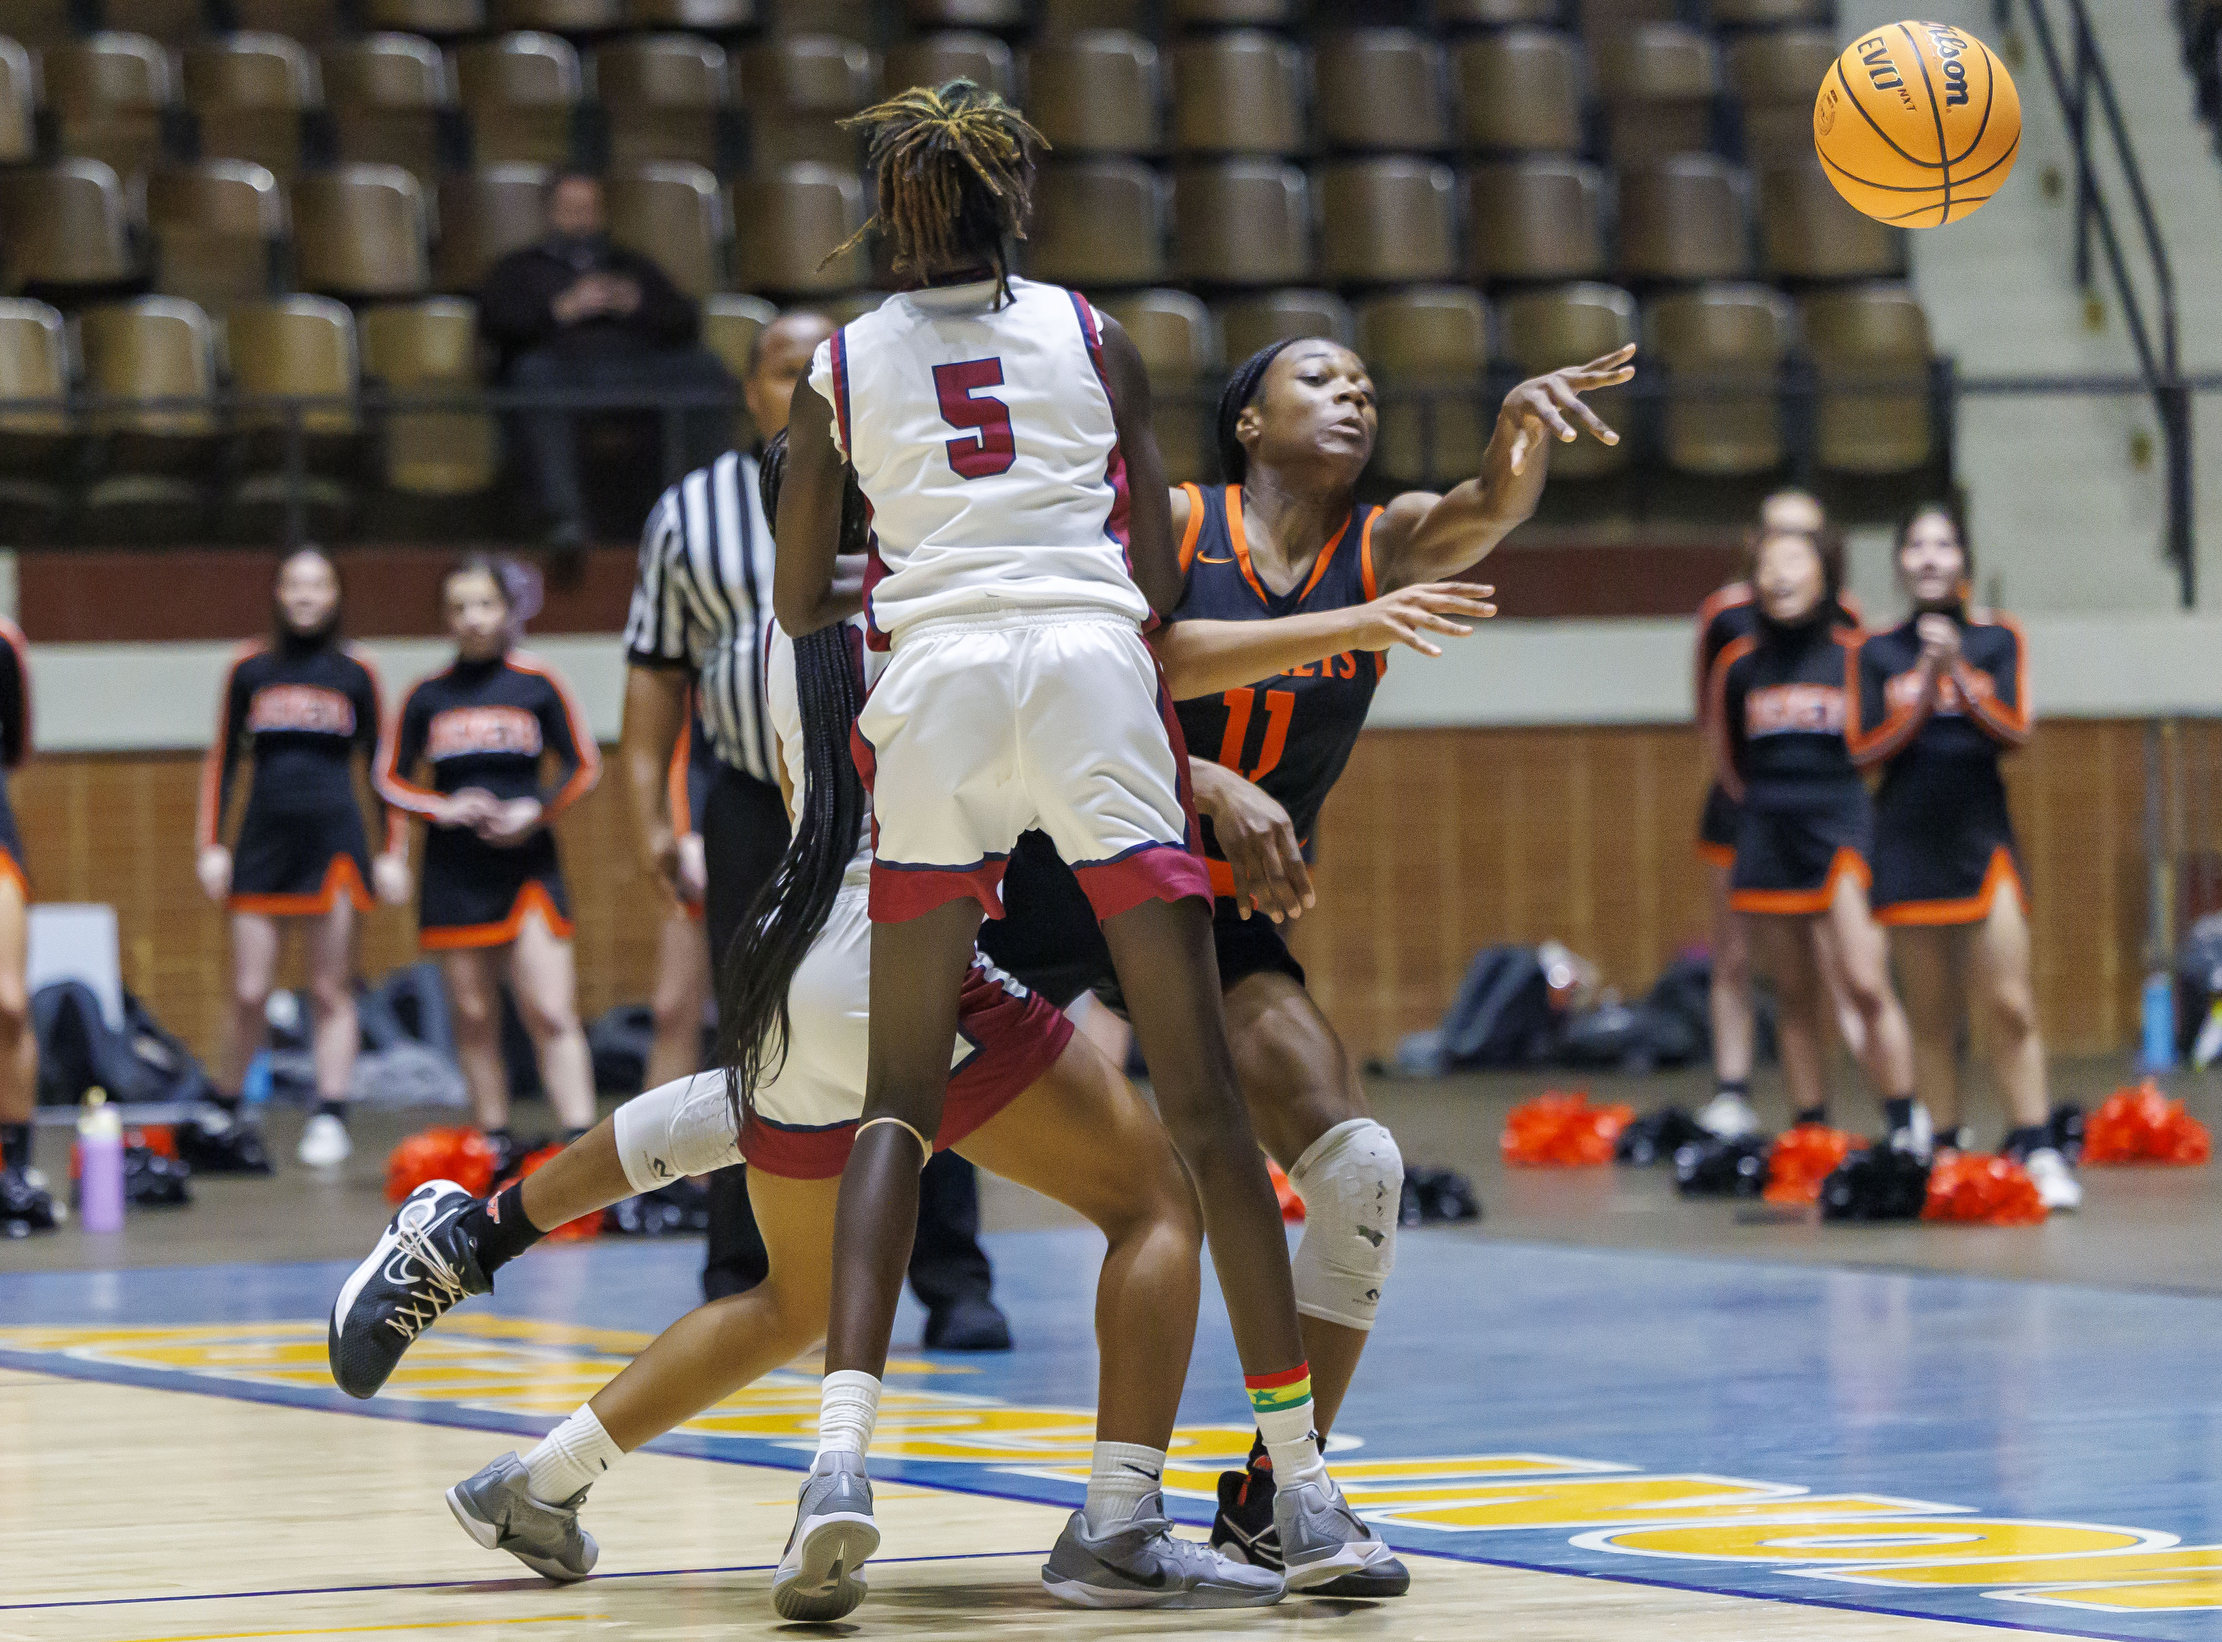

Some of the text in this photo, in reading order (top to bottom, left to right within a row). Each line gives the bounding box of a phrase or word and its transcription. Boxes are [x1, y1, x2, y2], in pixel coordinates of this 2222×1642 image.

[1898, 88, 1918, 112] NXT
[931, 356, 1017, 481] 5
[1219, 687, 1296, 785] 11
